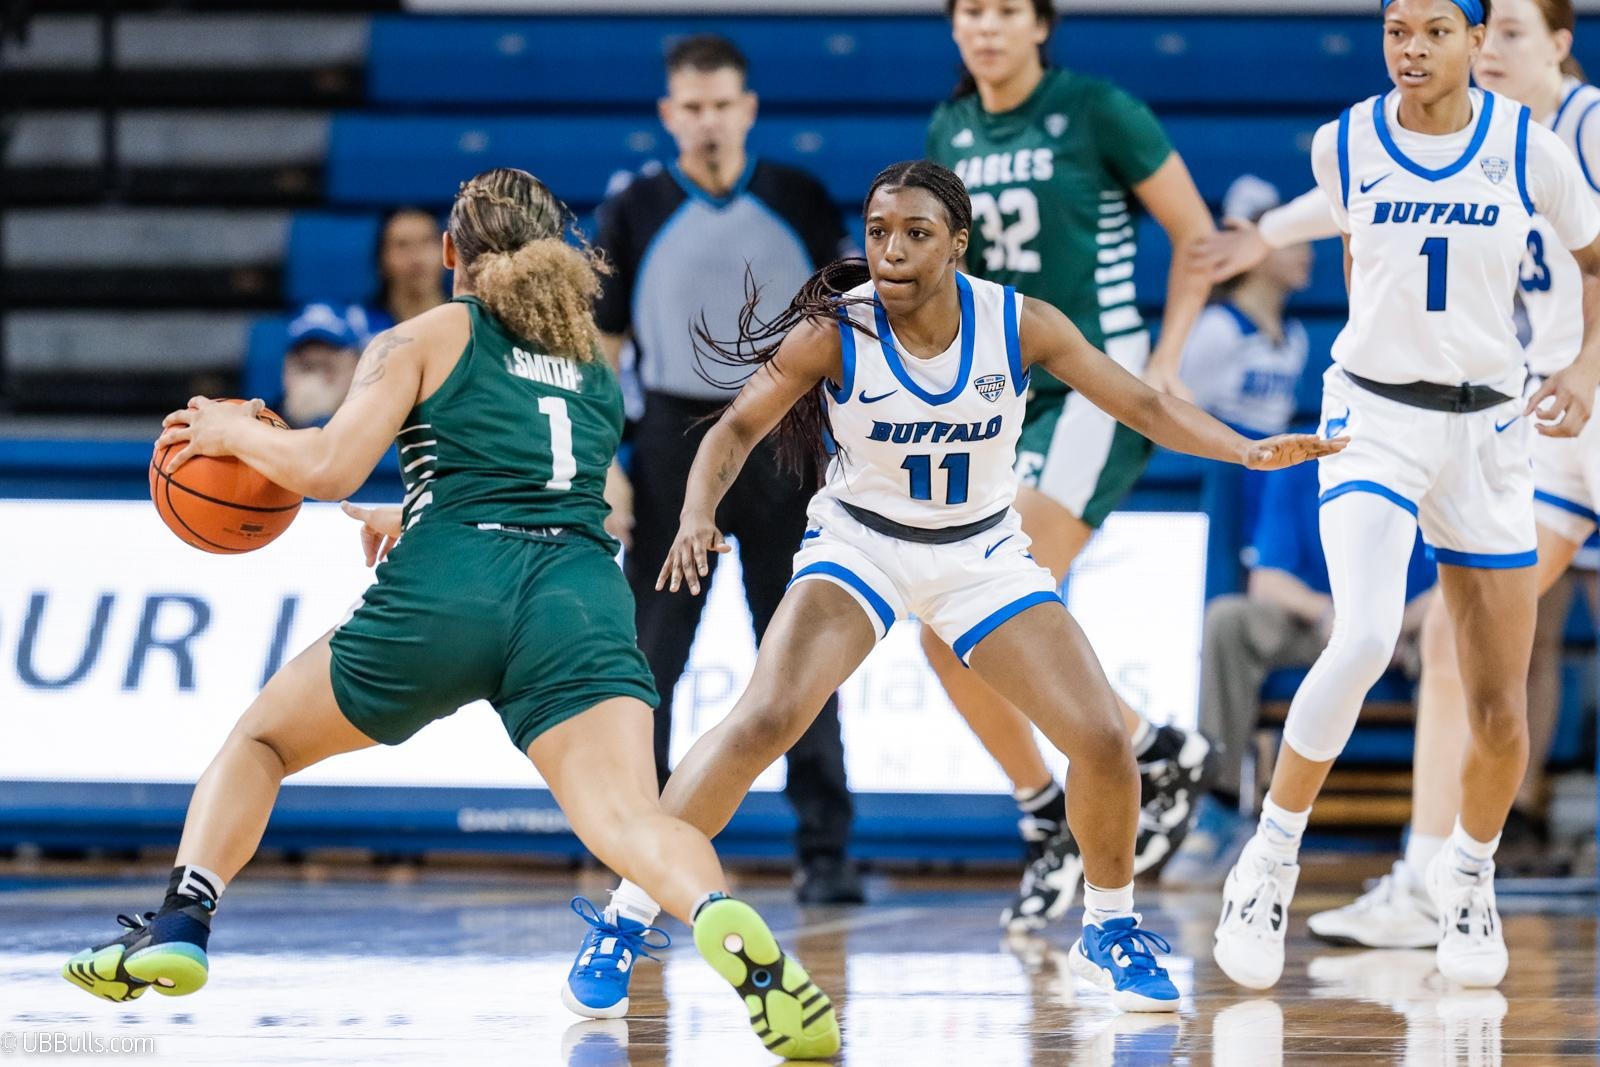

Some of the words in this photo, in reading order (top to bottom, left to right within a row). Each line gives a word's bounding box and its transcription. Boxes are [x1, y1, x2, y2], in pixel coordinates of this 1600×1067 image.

[970, 187, 1041, 272] 32
[1370, 201, 1500, 227] BUFFALO
[1419, 237, 1448, 311] 1
[512, 346, 577, 391] SMITH
[537, 396, 577, 491] 1
[866, 414, 1003, 444] BUFFALO
[900, 452, 970, 505] 11
[0, 592, 212, 690] UR
